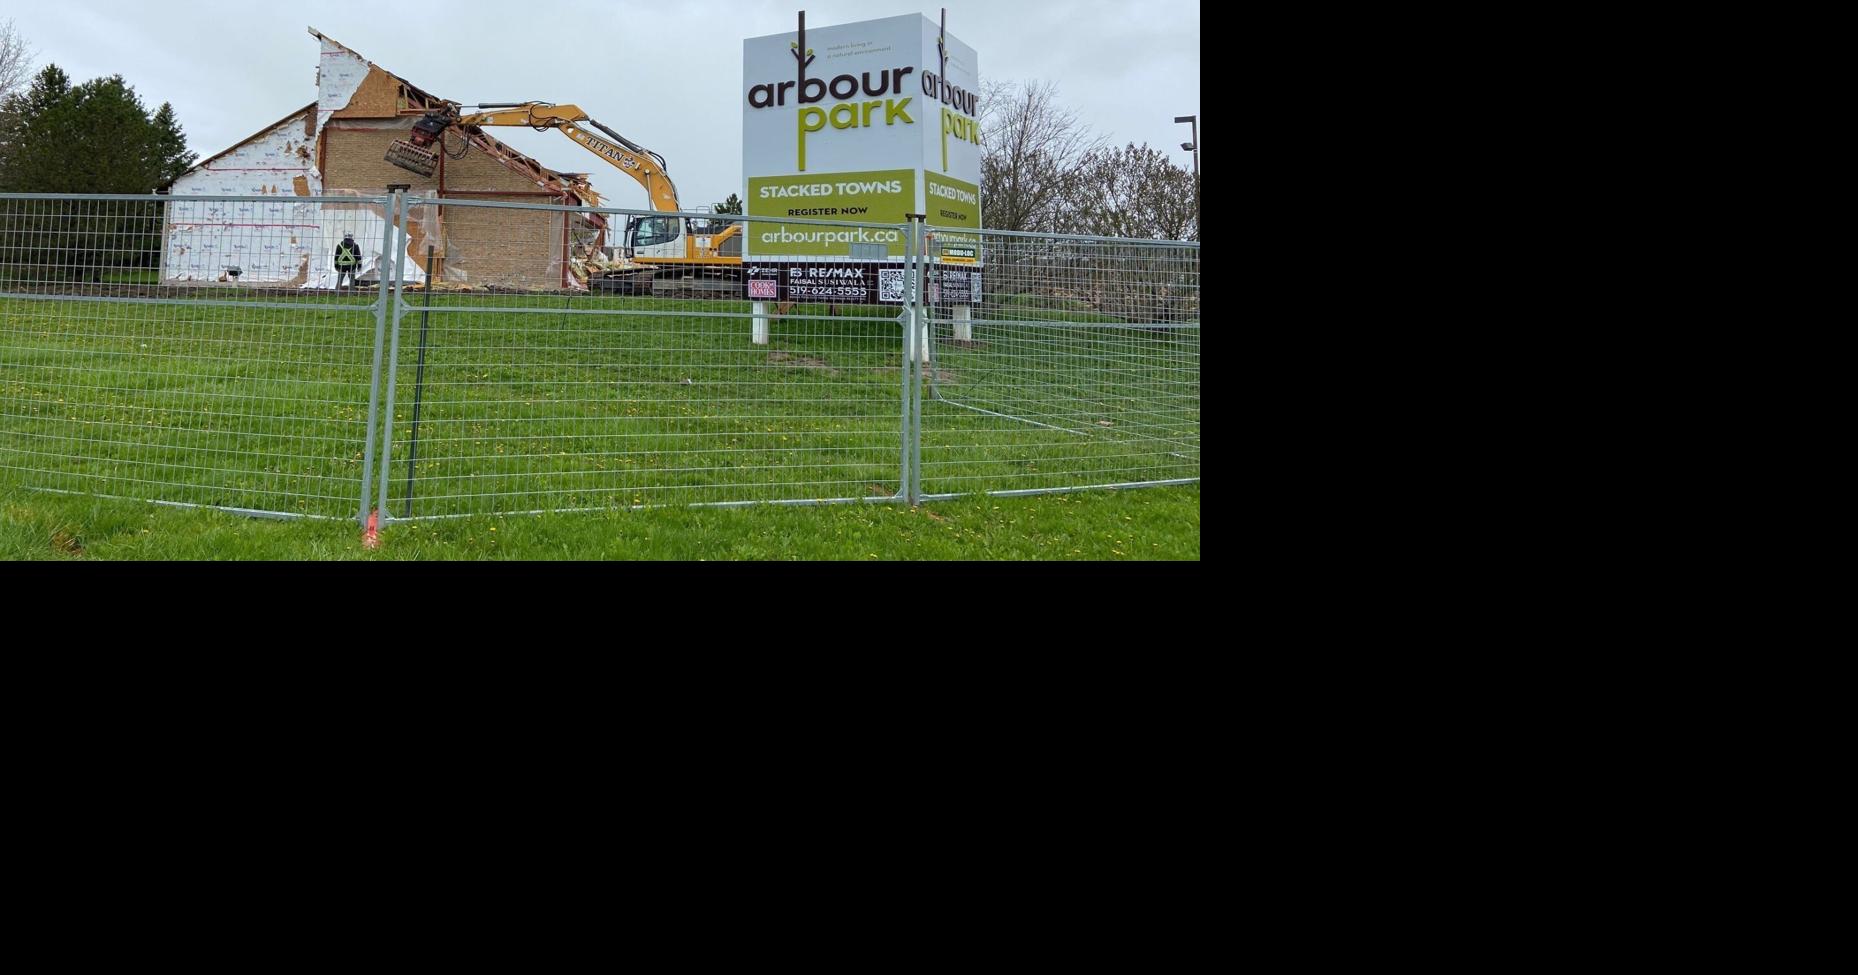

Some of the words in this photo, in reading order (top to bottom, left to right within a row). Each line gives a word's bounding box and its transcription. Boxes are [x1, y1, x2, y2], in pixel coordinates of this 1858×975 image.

[798, 97, 914, 171] park
[942, 107, 981, 172] park
[585, 136, 624, 161] TITAN
[759, 183, 833, 199] STACKED
[836, 180, 902, 196] TOWNS
[929, 182, 957, 200] STACKED
[957, 189, 976, 206] TOWNS
[788, 208, 838, 217] REGISTER
[841, 206, 868, 215] NOW
[761, 225, 899, 247] arbourpark.ca
[790, 278, 816, 286] FAISAL
[818, 278, 866, 287] SUSIWALA
[809, 267, 864, 279] RE/MAX
[790, 285, 867, 295] 519-624-5555
